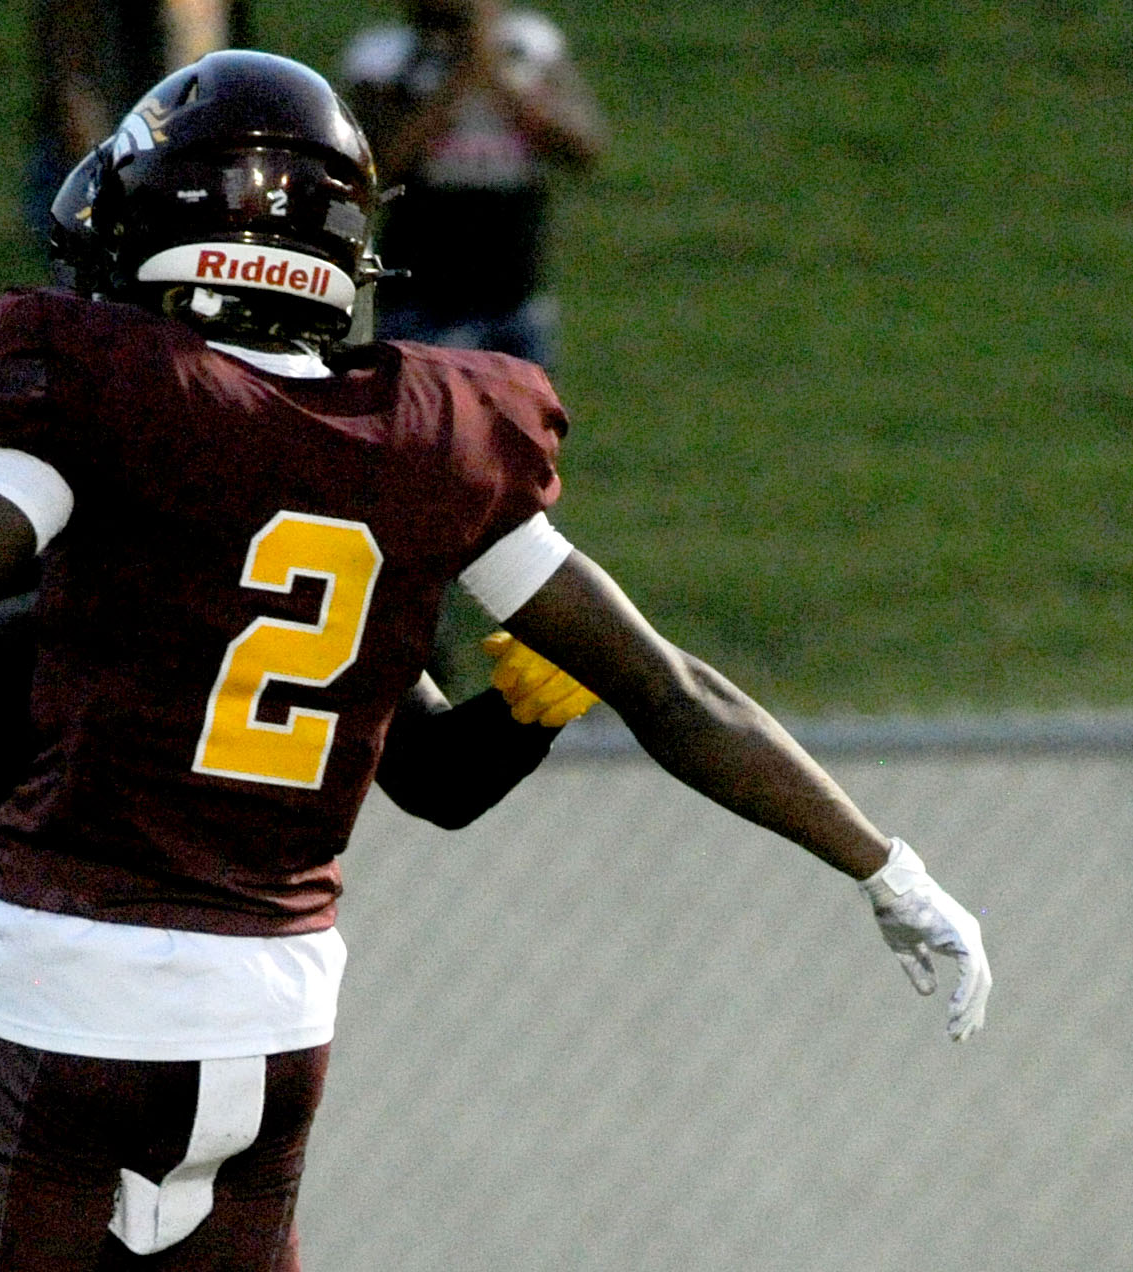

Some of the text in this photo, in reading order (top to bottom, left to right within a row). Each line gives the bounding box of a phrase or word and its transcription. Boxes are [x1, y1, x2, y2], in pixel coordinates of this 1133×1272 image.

[267, 189, 288, 216] 2
[196, 250, 331, 297] Riddell
[191, 509, 384, 791] 2
